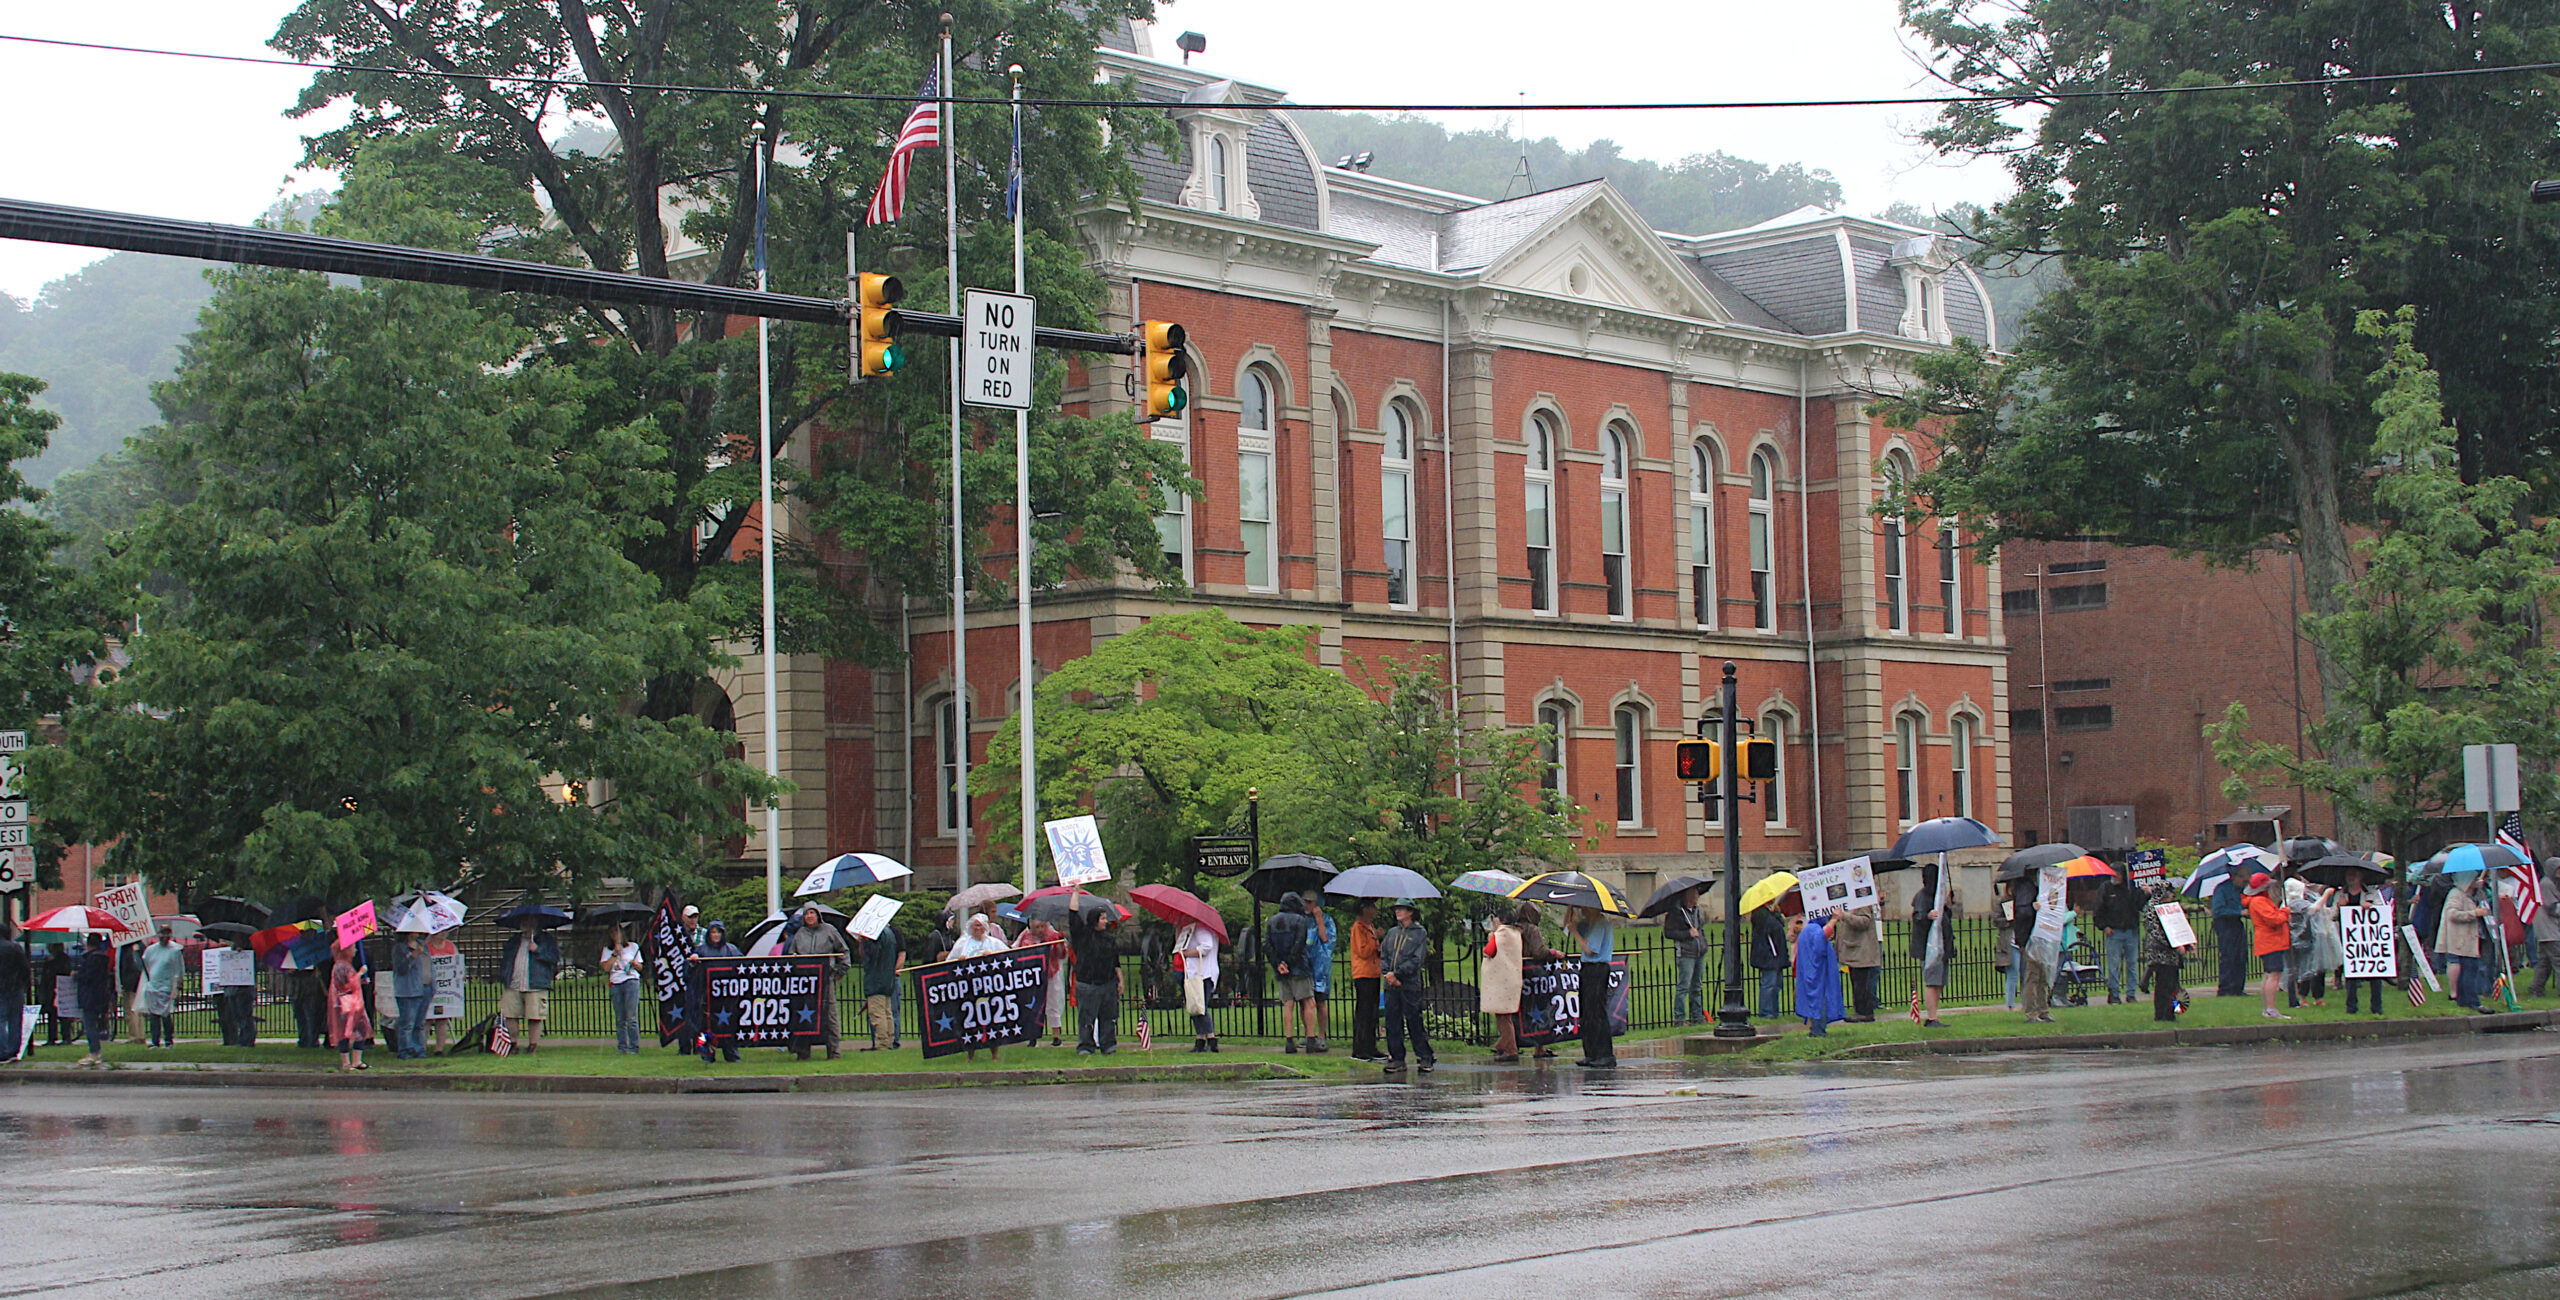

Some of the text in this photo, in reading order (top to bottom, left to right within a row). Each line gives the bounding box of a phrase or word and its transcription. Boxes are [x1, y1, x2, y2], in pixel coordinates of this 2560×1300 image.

[986, 302, 1014, 328] NO
[979, 331, 1020, 352] TURN
[987, 356, 1010, 375] ON
[983, 379, 1012, 398] RED
[0, 735, 24, 748] UTH
[0, 764, 22, 788] 2
[0, 858, 14, 882] 6
[1207, 855, 1249, 866] ENTRANCE
[2132, 860, 2161, 871] VETERANS
[1816, 866, 1845, 877] IMPEACH
[2134, 868, 2161, 878] AGAINST
[1803, 875, 1839, 890] CONVICT
[96, 886, 138, 910] EMPATHY
[2352, 908, 2380, 925] NO
[2346, 925, 2390, 942] KING
[2345, 943, 2391, 959] SINCE
[2350, 960, 2388, 973] 1776
[711, 975, 818, 997] STOP PROJECT
[928, 966, 1042, 1004] STOP PROJECT
[1522, 970, 1624, 996] STOP PRCT
[738, 998, 791, 1027] 2025
[961, 993, 1020, 1029] 2025
[1551, 991, 1580, 1021] 20
